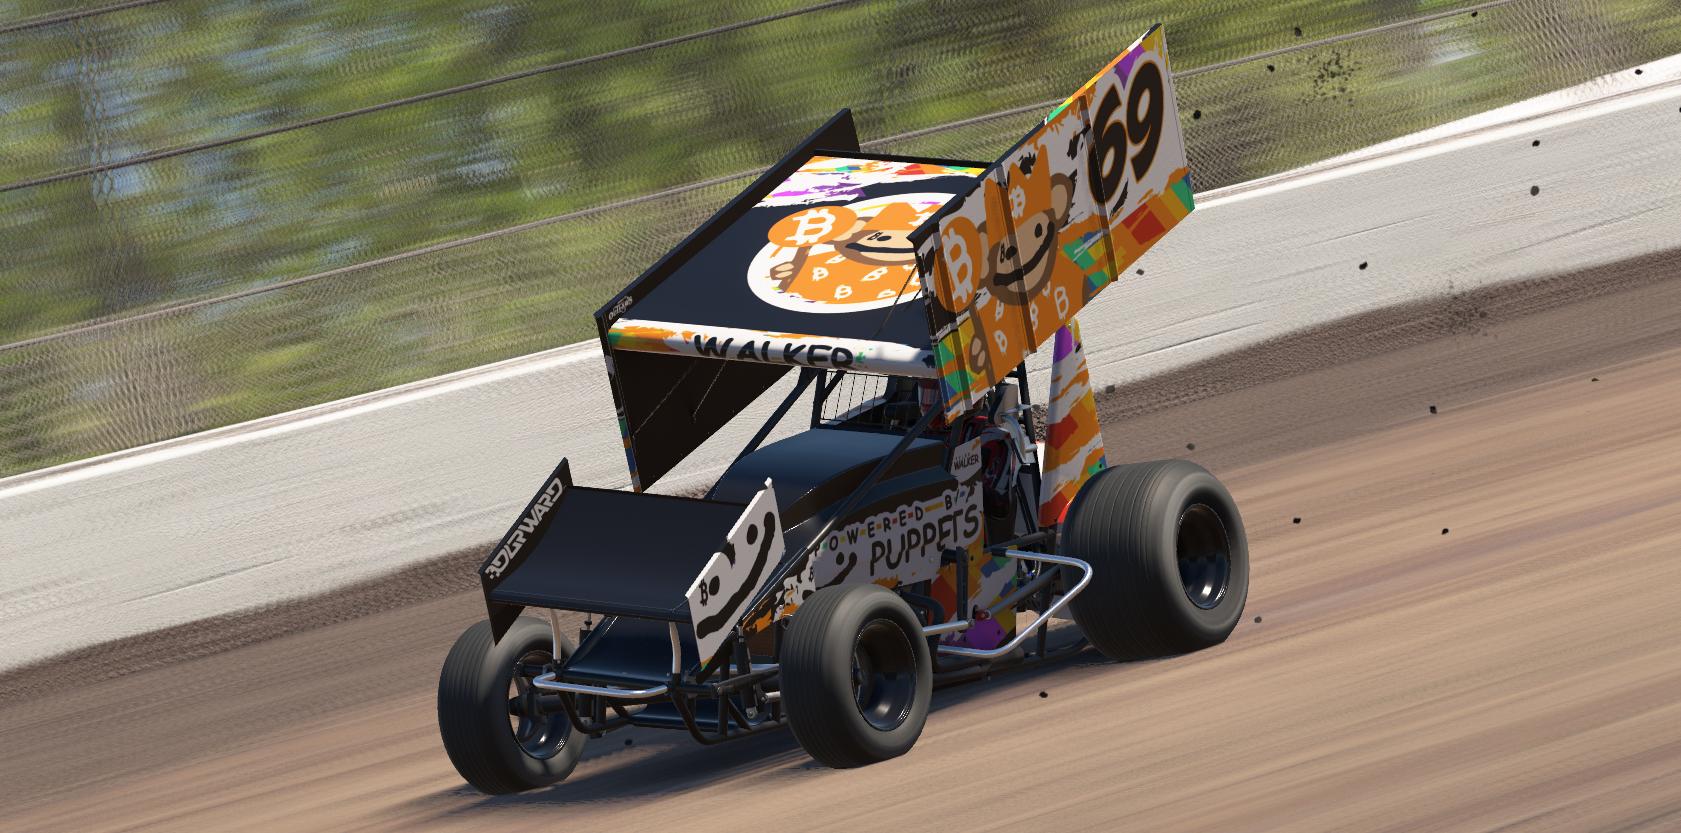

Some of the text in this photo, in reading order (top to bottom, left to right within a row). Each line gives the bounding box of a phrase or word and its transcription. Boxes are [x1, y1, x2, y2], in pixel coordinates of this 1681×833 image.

[1088, 60, 1164, 203] 69
[693, 334, 858, 370] WALKER
[954, 453, 980, 471] WALKER
[870, 504, 980, 576] PUPPETS
